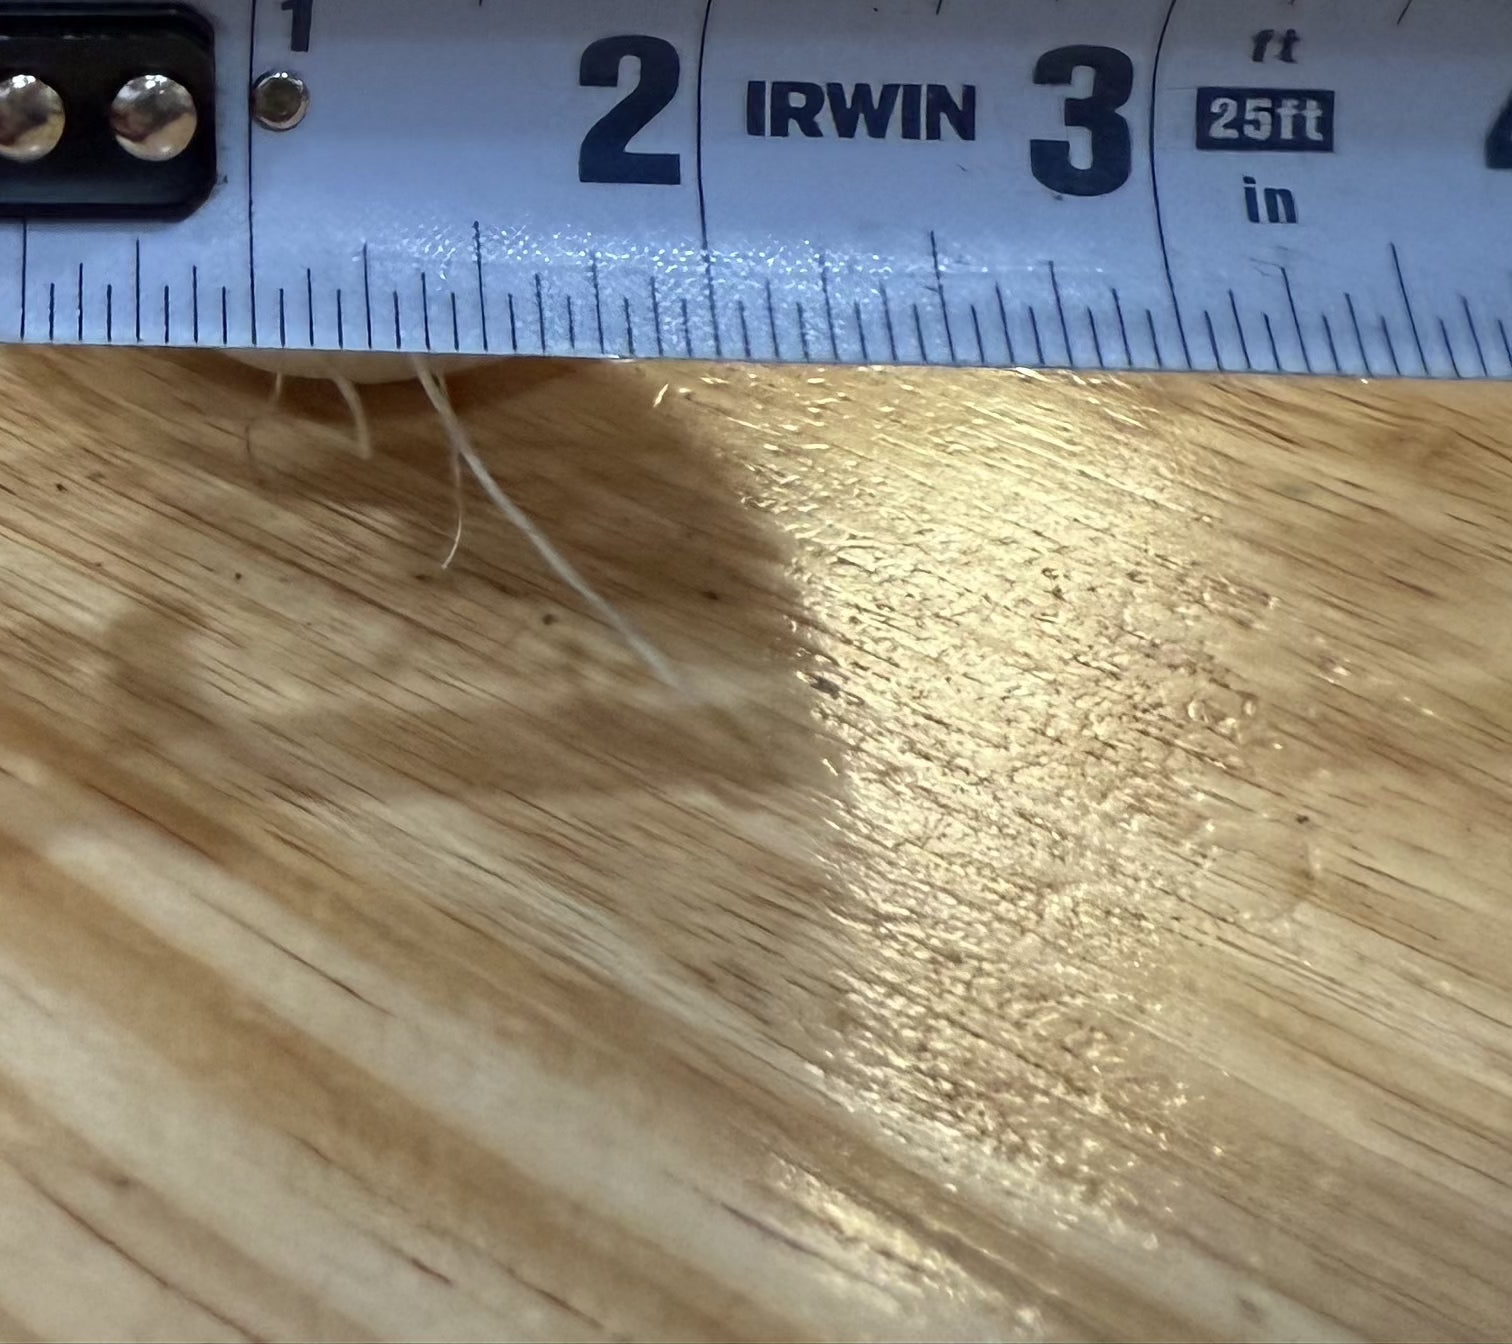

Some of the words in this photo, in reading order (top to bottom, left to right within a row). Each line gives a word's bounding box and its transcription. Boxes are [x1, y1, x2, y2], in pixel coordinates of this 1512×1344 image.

[1249, 27, 1302, 64] ft
[577, 33, 682, 186] 2
[745, 79, 977, 142] IRWIN
[1029, 44, 1135, 198] 3
[1208, 97, 1326, 143] 25ft
[1242, 175, 1300, 224] in
